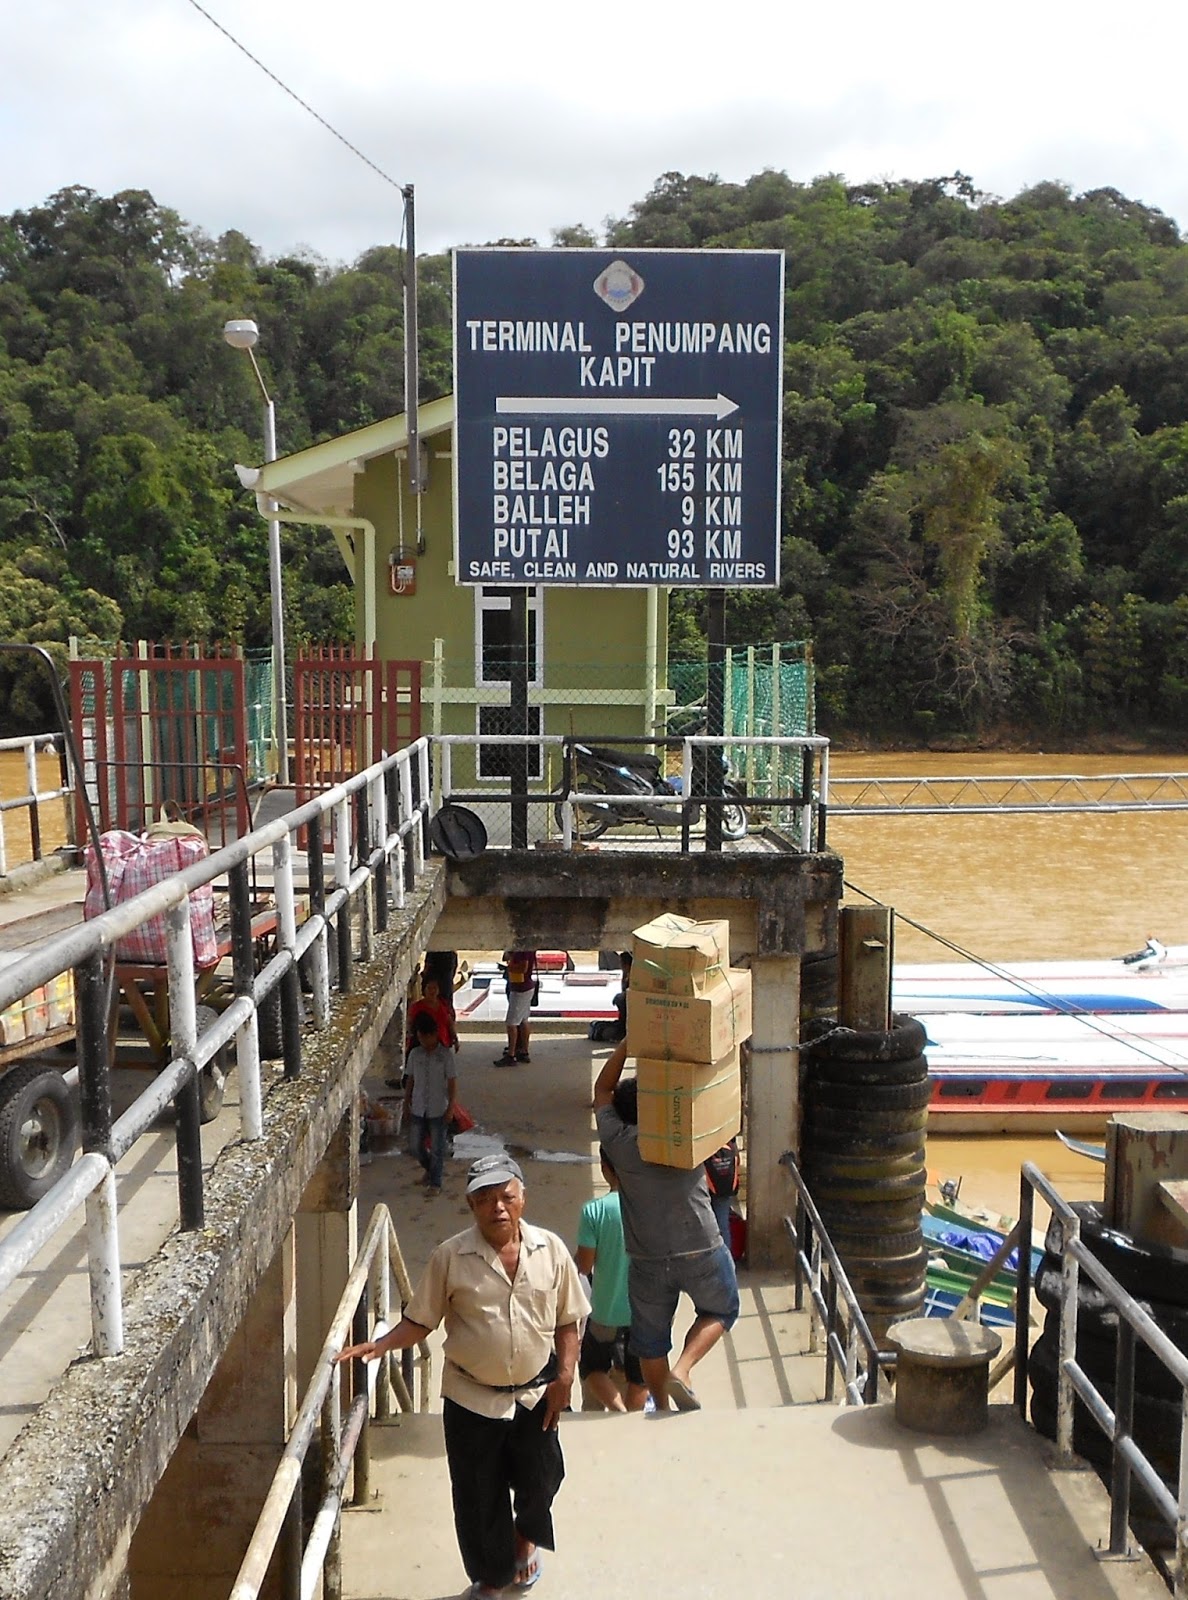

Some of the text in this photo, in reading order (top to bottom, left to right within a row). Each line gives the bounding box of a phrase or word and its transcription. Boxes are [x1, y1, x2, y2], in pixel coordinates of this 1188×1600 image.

[465, 320, 771, 353] TERMINAL PENUMPANG
[580, 356, 656, 387] KAPIT
[493, 427, 743, 459] PELAGUS 32 KM
[493, 461, 742, 492] BELAGA 155 KM
[493, 495, 742, 526] BALLEH 9 KM
[494, 528, 742, 559] PUTAI 93 KM
[469, 561, 766, 580] SAFE, CLEAN AND NATURAL RIVERS
